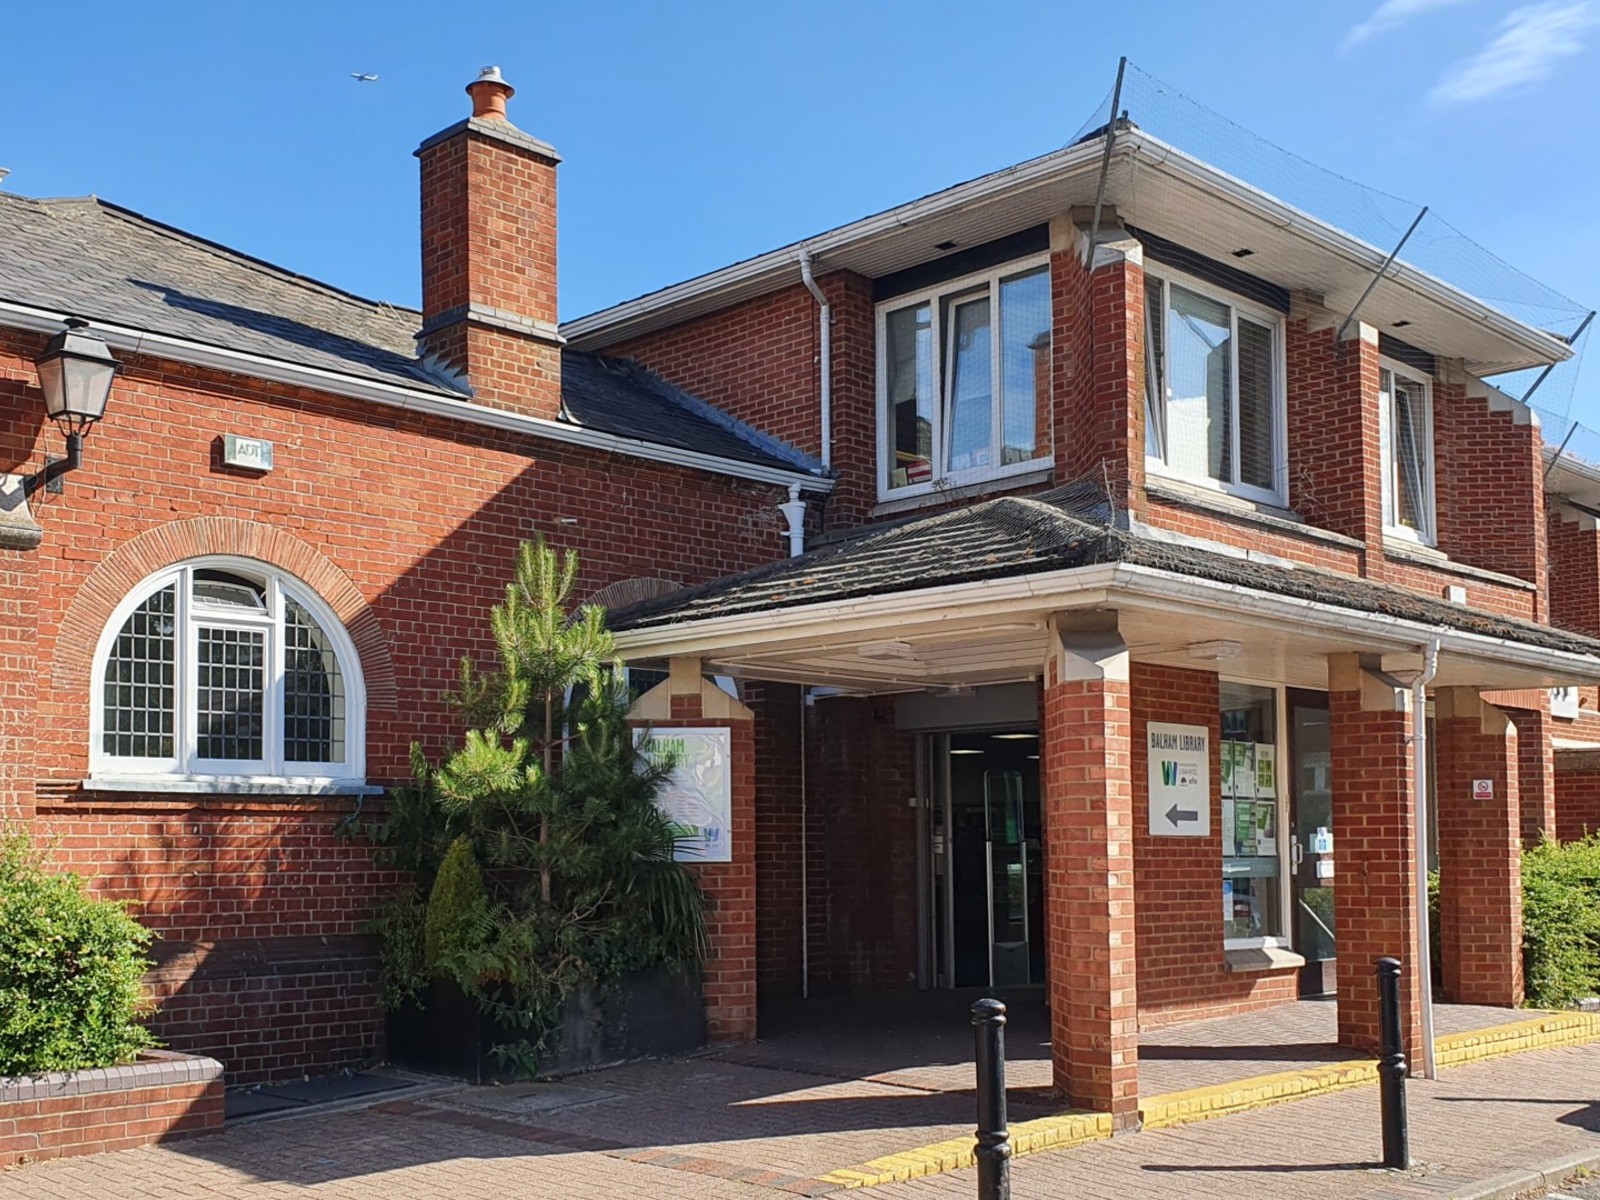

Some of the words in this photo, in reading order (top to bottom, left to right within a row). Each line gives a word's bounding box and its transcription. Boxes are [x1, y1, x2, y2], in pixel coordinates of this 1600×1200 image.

[237, 443, 261, 457] ADT
[1151, 732, 1178, 750] BALHAM
[1179, 734, 1206, 752] LIBRARY
